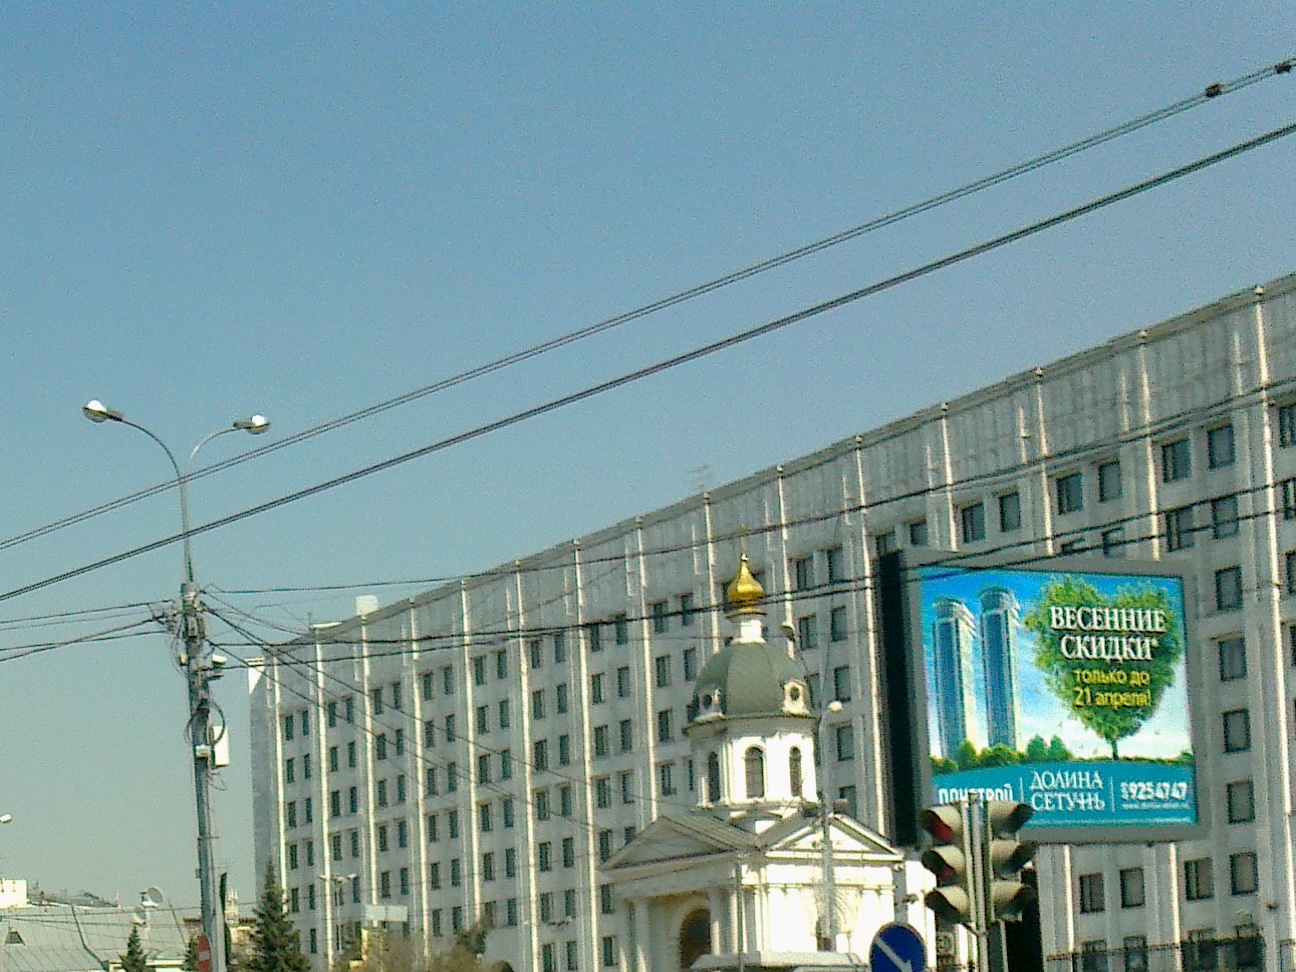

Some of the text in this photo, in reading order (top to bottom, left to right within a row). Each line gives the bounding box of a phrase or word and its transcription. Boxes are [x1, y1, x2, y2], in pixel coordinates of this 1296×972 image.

[1050, 606, 1167, 633] ВЕСЕННИЕ
[1074, 669, 1151, 687] только до
[1073, 687, 1092, 707] 21
[1029, 769, 1104, 792] ДОЛИНА
[1030, 791, 1106, 812] СЕТУНЬ
